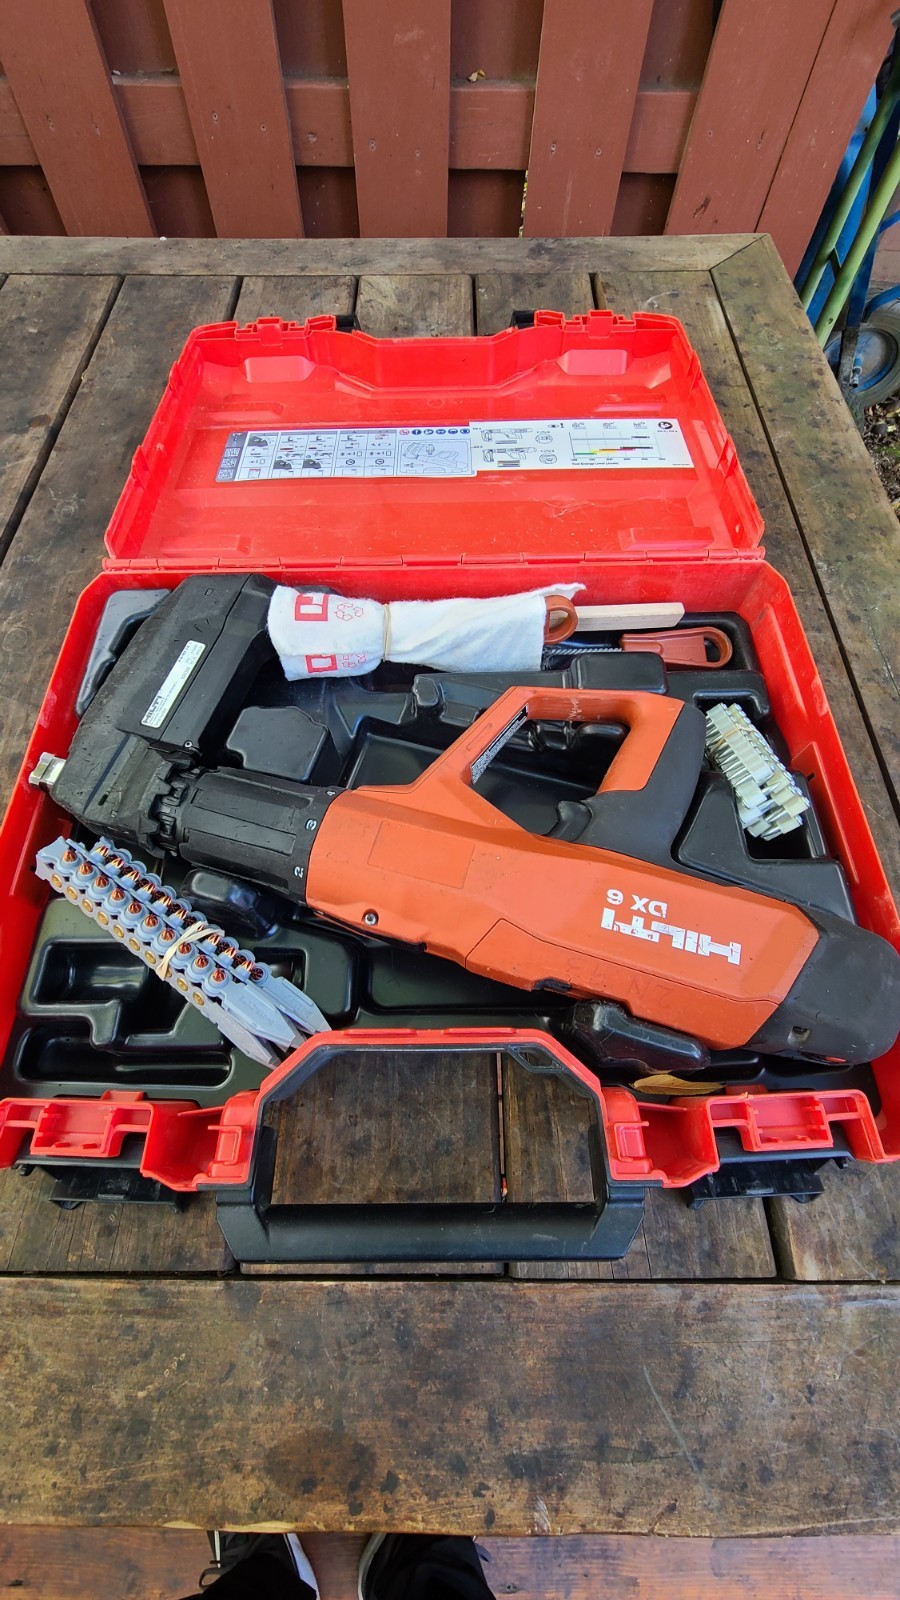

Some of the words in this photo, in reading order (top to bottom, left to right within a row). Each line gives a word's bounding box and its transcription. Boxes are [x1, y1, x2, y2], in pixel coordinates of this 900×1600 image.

[143, 695, 163, 724] HILTI
[306, 819, 317, 831] 3
[293, 866, 305, 879] 2
[606, 888, 624, 905] 6
[630, 894, 668, 918] DX
[601, 907, 742, 966] HILTI
